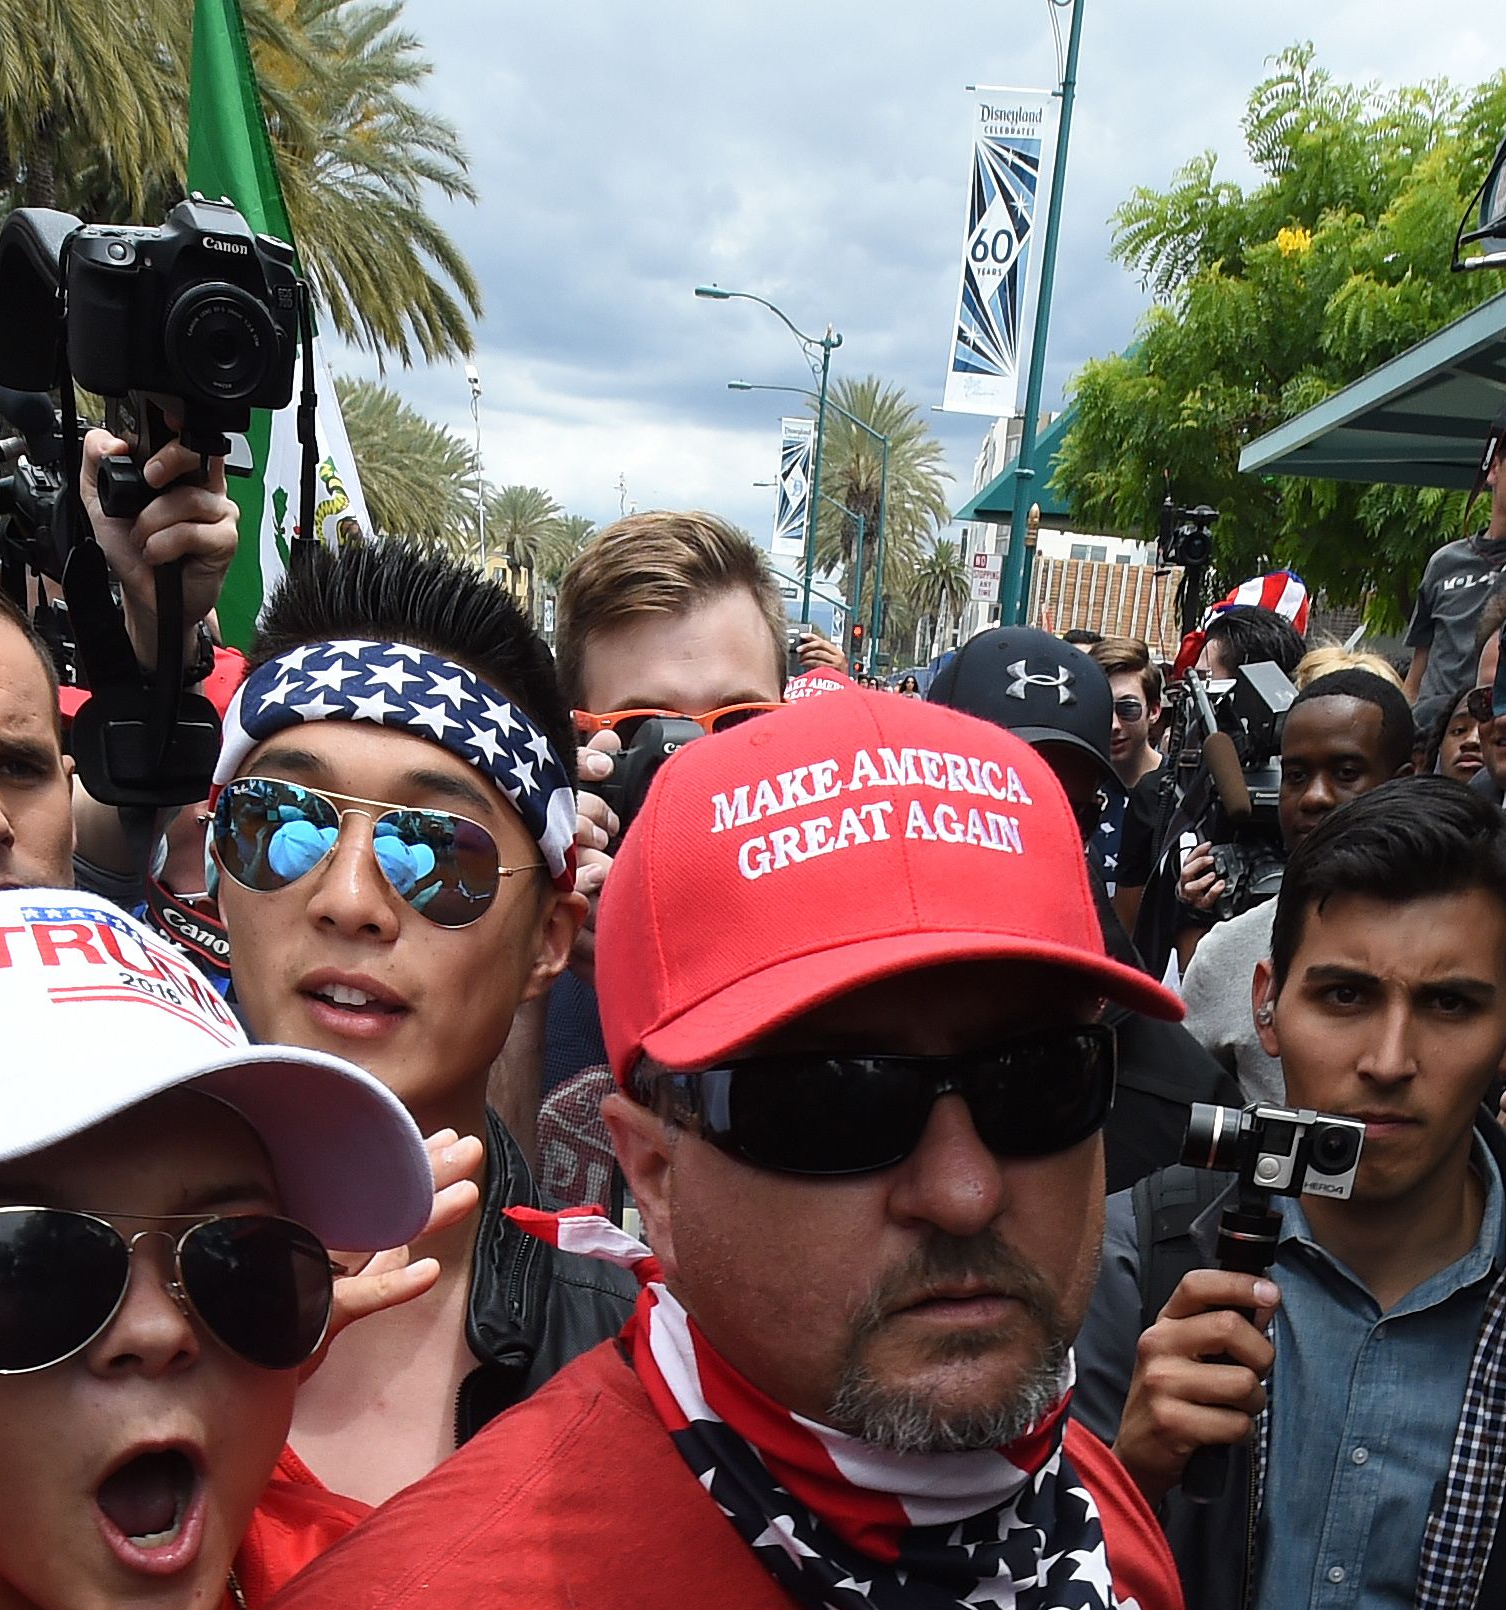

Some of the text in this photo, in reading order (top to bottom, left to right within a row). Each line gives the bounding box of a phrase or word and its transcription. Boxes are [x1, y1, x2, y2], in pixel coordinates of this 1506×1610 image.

[979, 103, 1042, 126] Disneyland
[202, 236, 248, 255] Canon
[970, 227, 1014, 264] 60
[710, 747, 1033, 833] MAKE AMERICA
[738, 800, 1024, 880] GREAT AGAIN
[162, 907, 231, 955] Cano
[1304, 1181, 1345, 1195] HERO4
